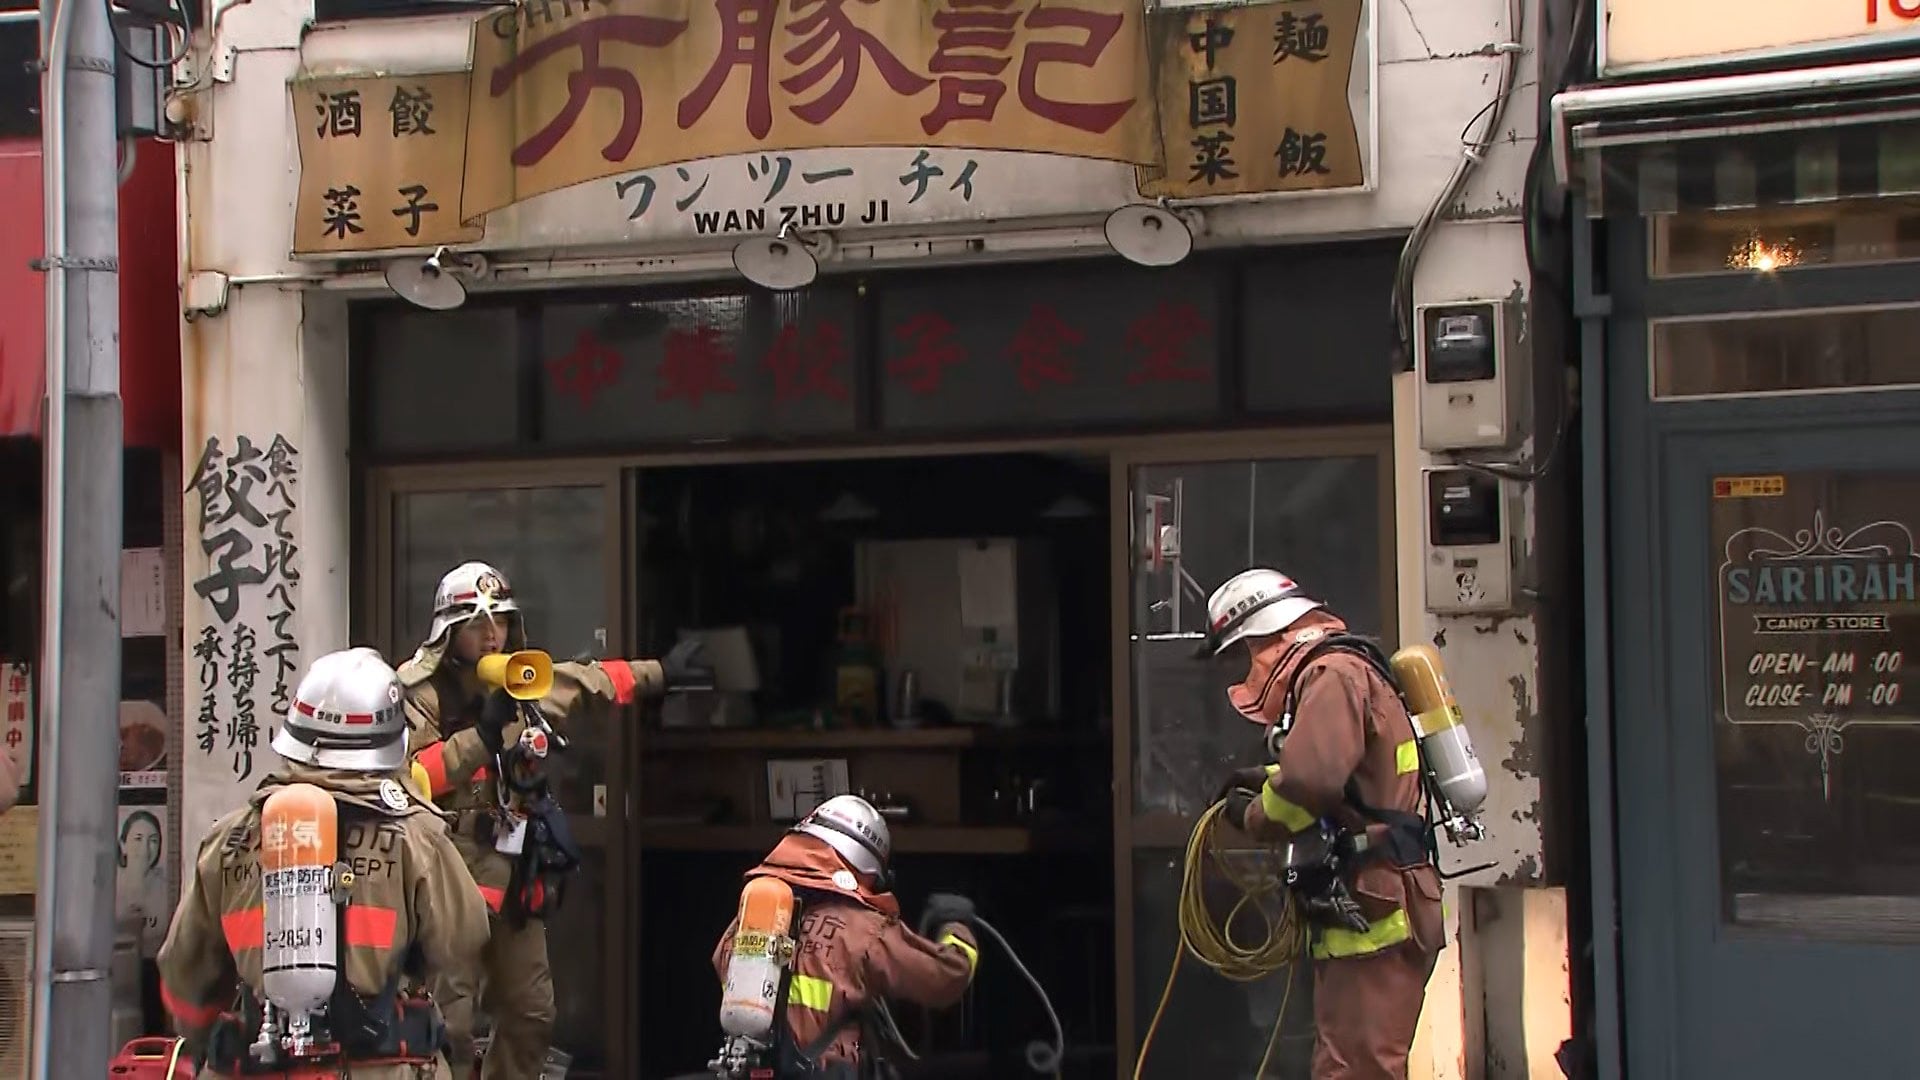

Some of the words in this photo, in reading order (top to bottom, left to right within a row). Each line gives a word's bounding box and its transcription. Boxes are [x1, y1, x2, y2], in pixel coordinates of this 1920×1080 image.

[388, 86, 438, 236] 餃子
[1188, 19, 1239, 184] 中国菜
[694, 207, 766, 234] WAN
[779, 202, 846, 230] ZHU
[860, 199, 889, 224] JI
[185, 435, 268, 623] 餃子
[263, 433, 299, 744] 食べて比べて下さ
[1728, 563, 1915, 603] SARIRAH
[194, 625, 226, 755] 承ります
[1767, 618, 1818, 631] CANDY
[1827, 617, 1881, 630] STORE
[227, 621, 261, 782] お持ち帰り
[1822, 683, 1853, 706] PM
